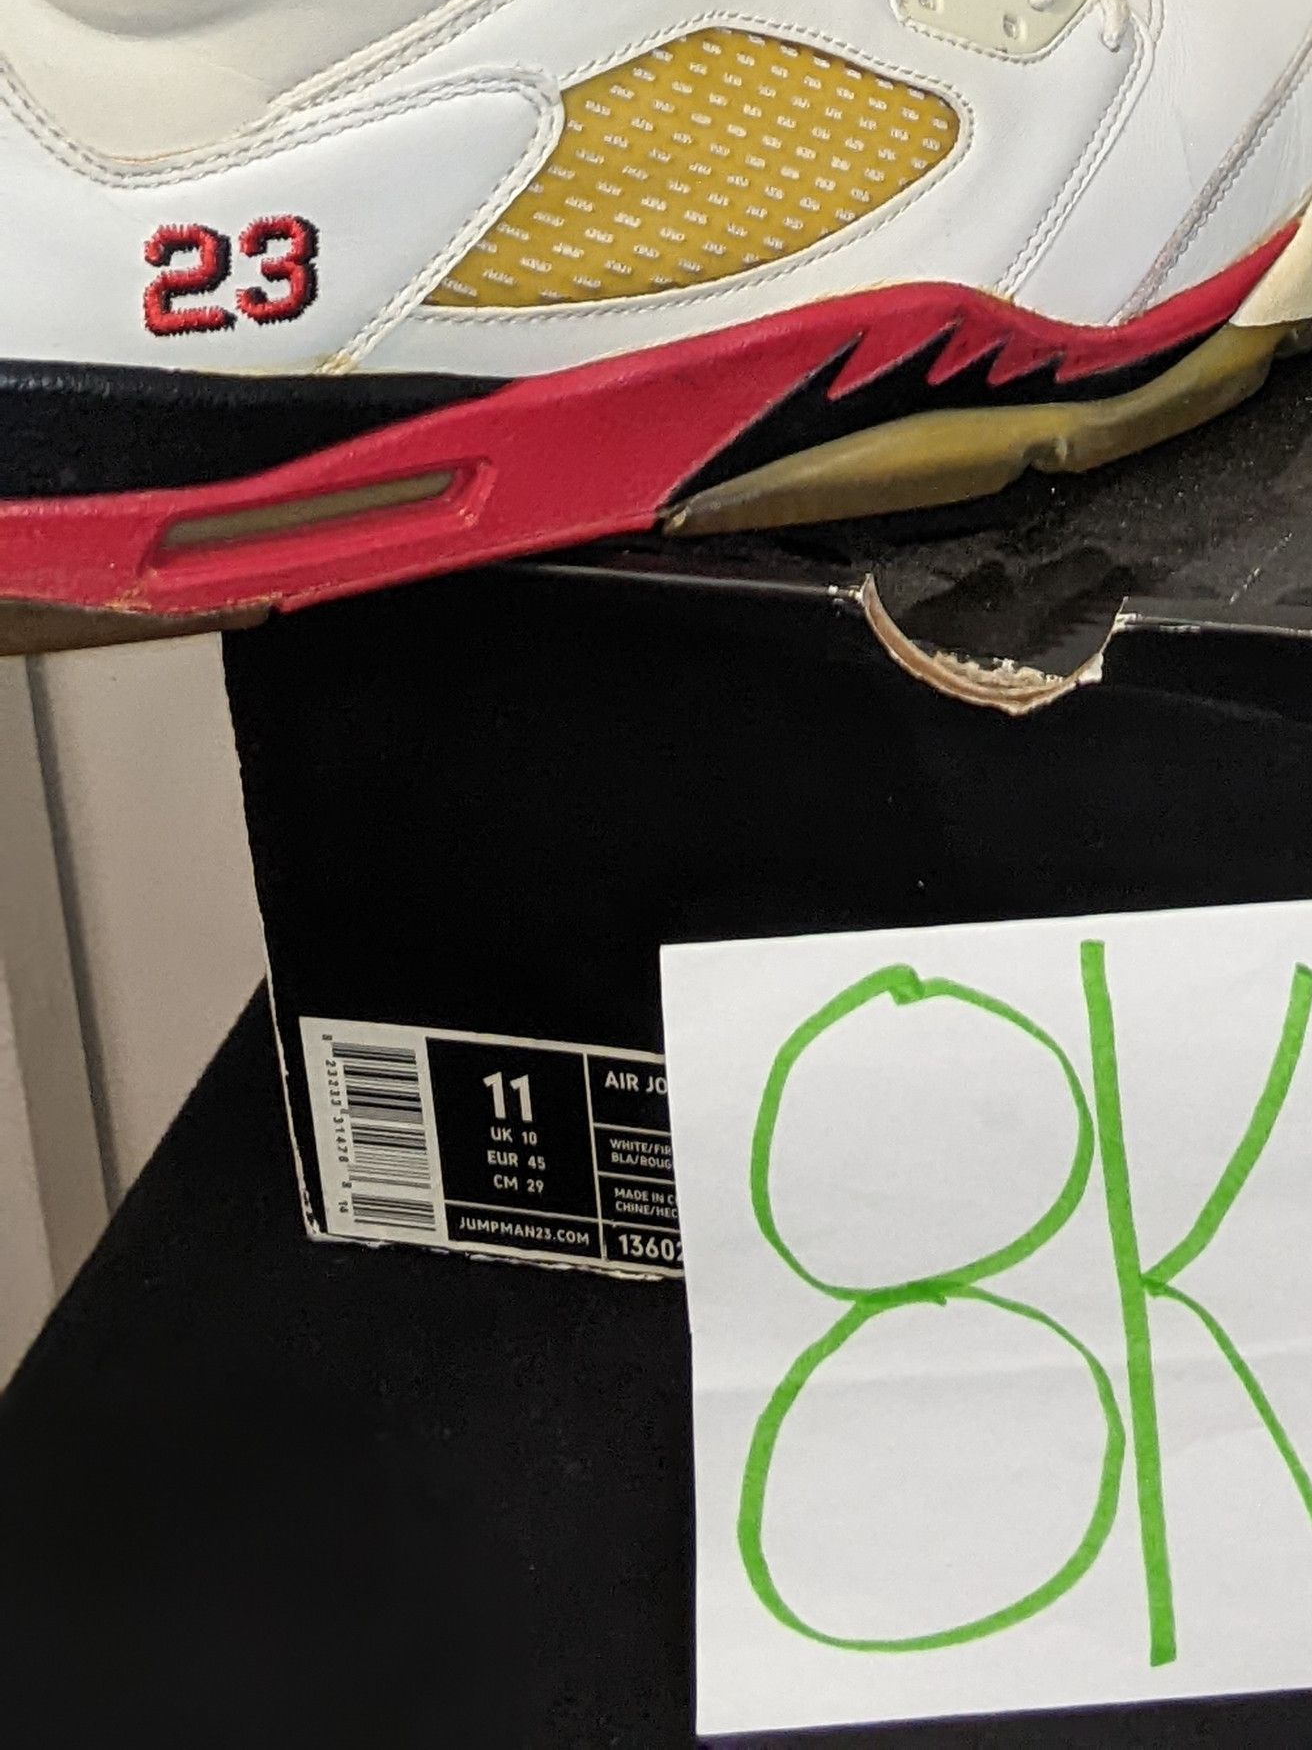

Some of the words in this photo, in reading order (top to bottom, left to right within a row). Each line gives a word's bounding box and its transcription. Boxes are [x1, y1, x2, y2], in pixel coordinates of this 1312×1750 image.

[143, 214, 319, 337] 23
[604, 1070, 639, 1092] AIR
[482, 1071, 533, 1123] 11
[490, 1126, 513, 1143] UK
[521, 1130, 538, 1146] 10
[487, 1150, 518, 1168] EUR
[527, 1155, 546, 1171] 45
[493, 1173, 519, 1191] CM
[526, 1178, 545, 1194] 29
[614, 1186, 649, 1202] MADE
[651, 1191, 665, 1204] IN
[459, 1216, 590, 1245] JUMPMAN23.COM
